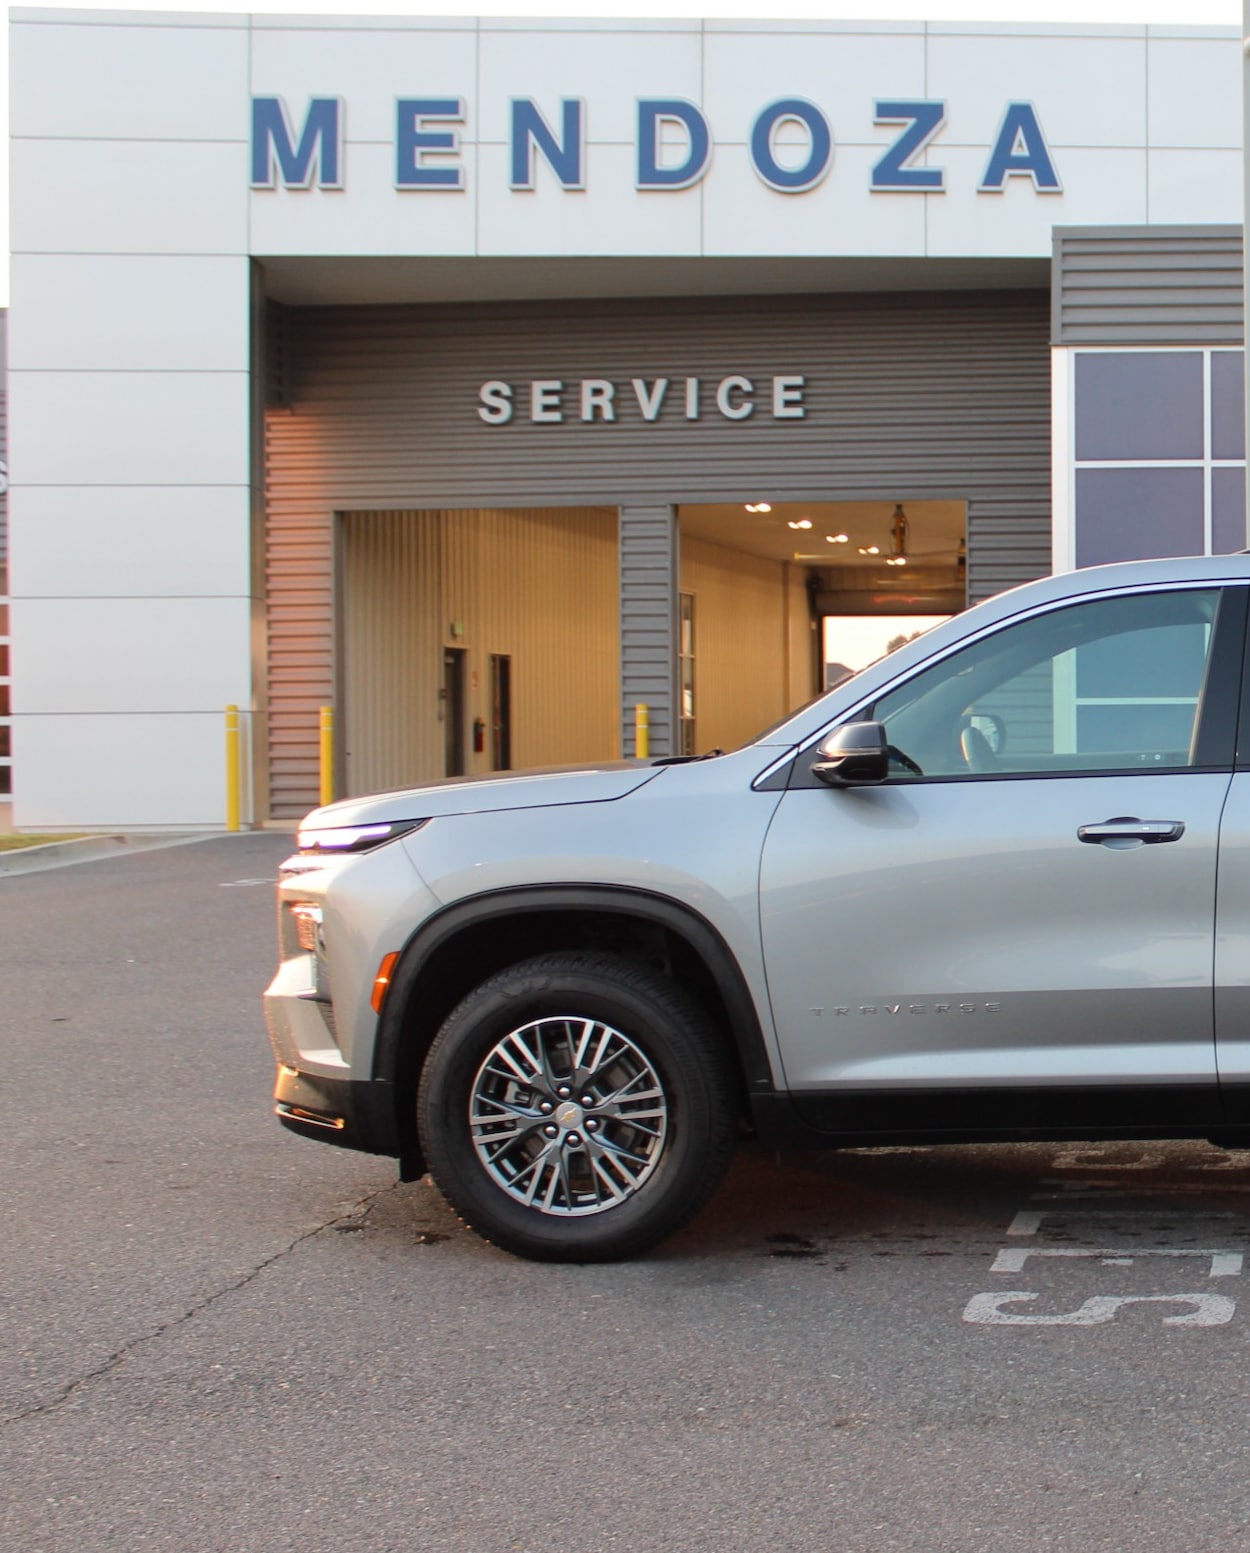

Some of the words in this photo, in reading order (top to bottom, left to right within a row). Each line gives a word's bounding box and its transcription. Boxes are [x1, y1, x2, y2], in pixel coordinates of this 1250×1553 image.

[249, 95, 1064, 194] MENDOZA
[478, 375, 807, 425] SERVICE
[808, 1002, 1001, 1018] TRAVERSE
